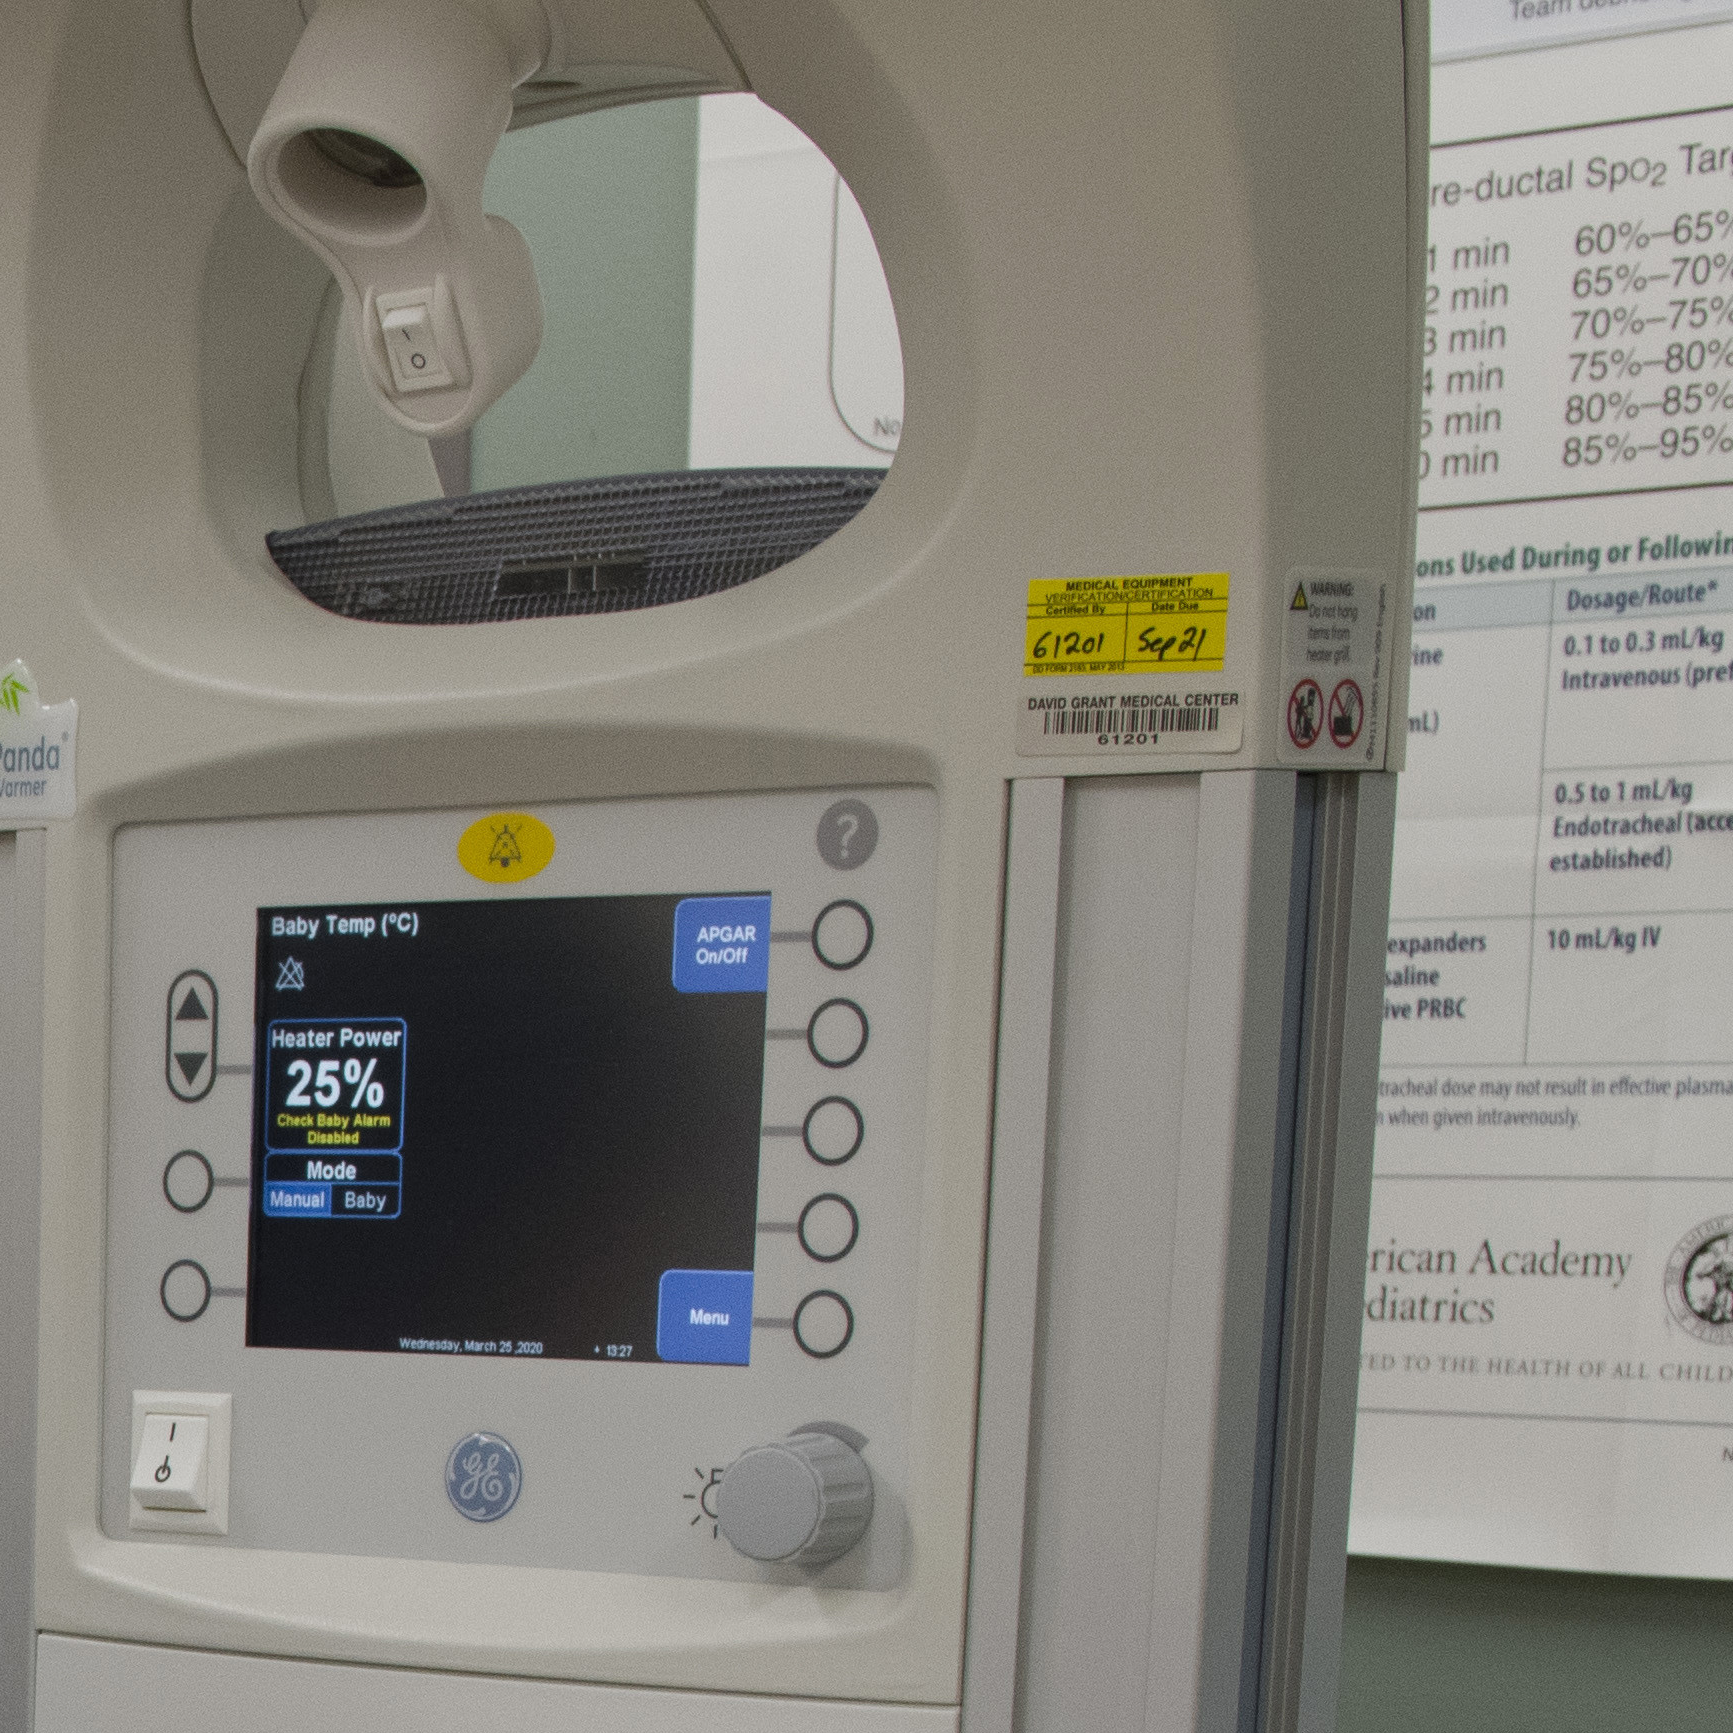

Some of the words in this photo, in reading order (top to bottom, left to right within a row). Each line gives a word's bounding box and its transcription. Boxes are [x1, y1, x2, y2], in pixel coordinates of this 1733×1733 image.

[1680, 142, 1733, 178] Tar
[1453, 236, 1510, 271] min
[1451, 277, 1508, 312] min
[1449, 320, 1506, 353] min
[1461, 545, 1516, 575] Used
[1521, 541, 1601, 572] During
[1607, 543, 1631, 564] or
[1045, 587, 1213, 603] VERIFICATION/CERTIFICATION
[1065, 579, 1118, 592] MEDICAL
[1122, 576, 1194, 590] EQUIPMENT
[1046, 604, 1090, 616] Certified
[1092, 603, 1106, 616] By
[1151, 601, 1175, 612] Date
[1178, 600, 1199, 611] Due
[1032, 631, 1105, 659] 61201
[1563, 634, 1593, 657] 0.1
[1600, 634, 1621, 655] to
[1626, 630, 1656, 653] 0.3
[1661, 625, 1725, 653] mL/kg
[1562, 665, 1681, 690] Intravenous
[1027, 697, 1067, 711] DAVID
[1071, 695, 1116, 710] GRANT
[1120, 693, 1180, 708] MEDICAL
[1184, 692, 1239, 707] CENTER
[1097, 733, 1160, 746] 61201
[1554, 782, 1584, 804] 0.5
[1591, 781, 1611, 803] to
[1618, 780, 1626, 801] 1
[1632, 777, 1693, 805] mL/kg
[1553, 811, 1683, 838] Endotracheal
[1549, 846, 1672, 872] established)
[271, 915, 319, 940] Baby
[326, 913, 376, 938] Temp
[696, 925, 757, 943] APGAR
[1387, 931, 1487, 958] expanders
[1547, 928, 1570, 950] 10
[1575, 926, 1637, 954] mL/kg
[1641, 925, 1662, 948] IV
[695, 946, 750, 965] On/Off
[271, 1028, 334, 1049] Heater
[339, 1026, 402, 1048] Power
[285, 1057, 384, 1108] 25%
[1442, 1079, 1477, 1097] dose
[1480, 1080, 1511, 1100] may
[1515, 1079, 1541, 1096] not
[1546, 1077, 1588, 1096] result
[1591, 1077, 1606, 1095] in
[1609, 1075, 1671, 1096] effective
[277, 1113, 313, 1128] Check
[317, 1113, 349, 1130] Baby
[353, 1112, 391, 1128] Alarm
[1389, 1107, 1428, 1126] when
[1433, 1107, 1473, 1131] given
[1477, 1107, 1581, 1130] intravenously.
[307, 1129, 360, 1145] Disabled
[306, 1160, 357, 1181] Mode
[270, 1190, 325, 1209] Manual
[344, 1190, 387, 1213] Baby
[1370, 1237, 1457, 1275] rican
[1468, 1238, 1633, 1291] Academy
[689, 1307, 730, 1327] Menu
[606, 1344, 633, 1358] 13:27
[1402, 1354, 1431, 1373] TO
[1438, 1355, 1480, 1376] THE
[1487, 1356, 1572, 1379] HEALTH
[1579, 1359, 1606, 1377] OF
[1612, 1361, 1651, 1381] ALL
